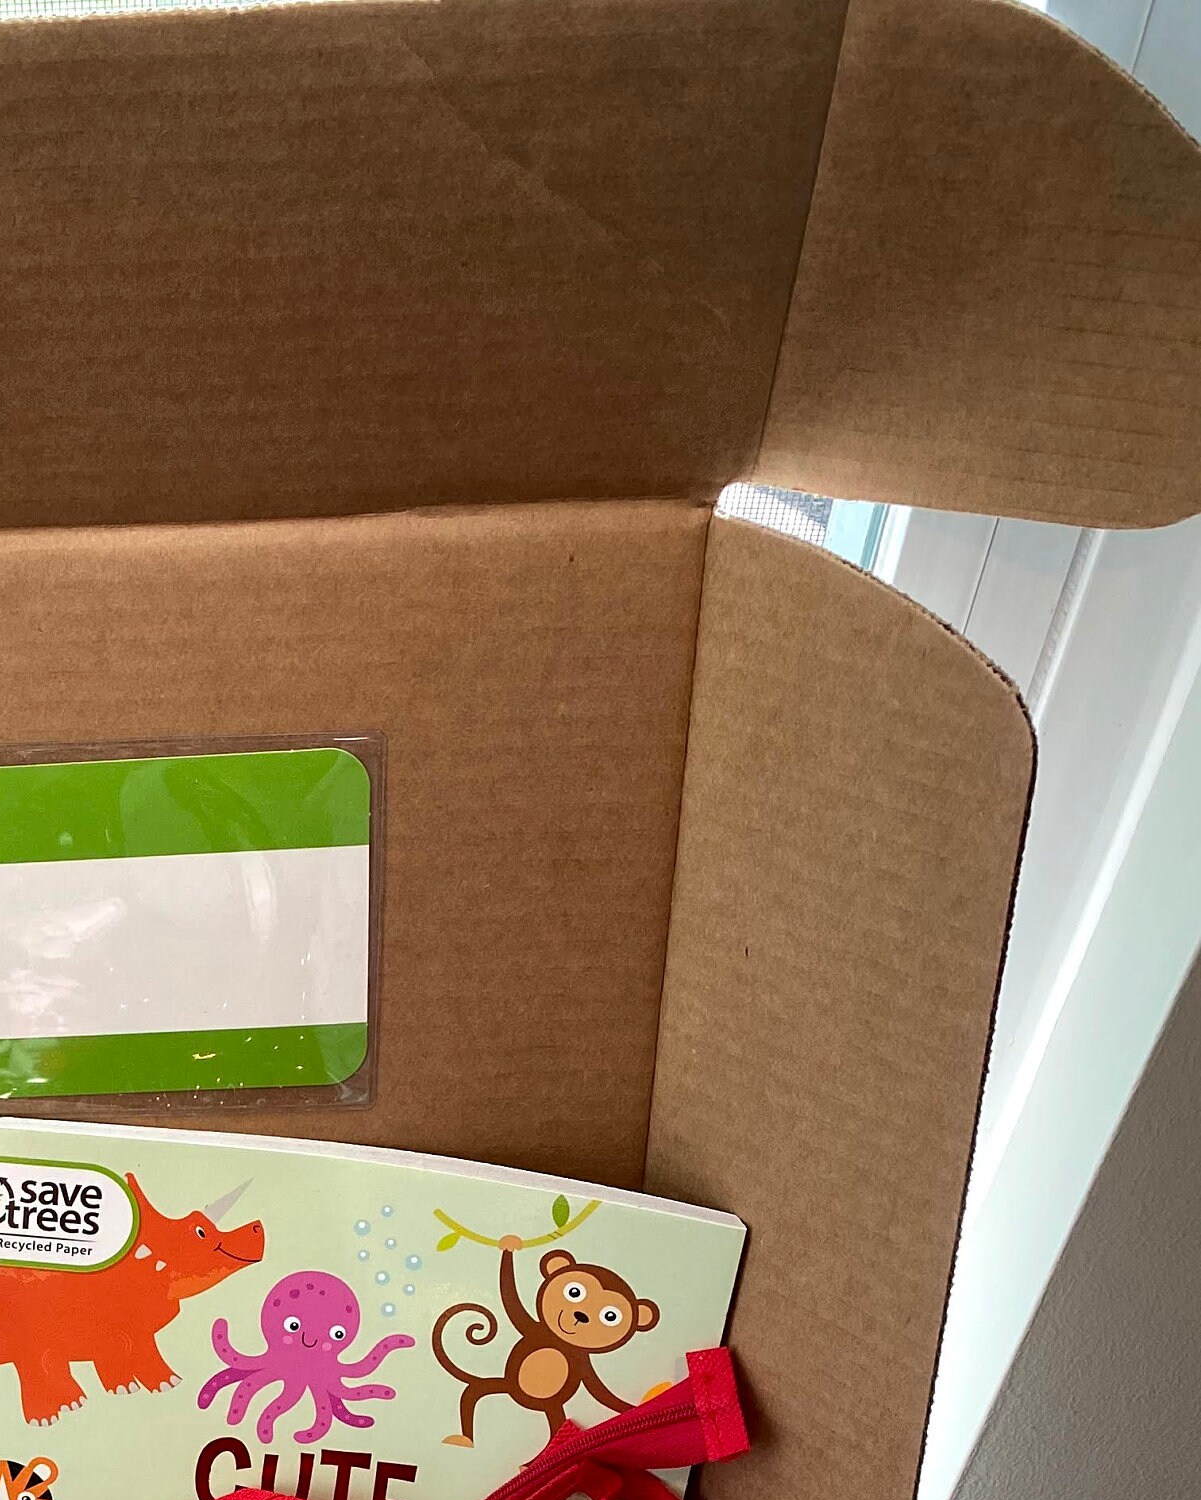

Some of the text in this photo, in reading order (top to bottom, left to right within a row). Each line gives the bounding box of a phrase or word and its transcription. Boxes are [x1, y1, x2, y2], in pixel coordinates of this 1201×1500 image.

[20, 1180, 102, 1209] save
[5, 1200, 99, 1236] trees
[56, 1243, 93, 1257] Paper
